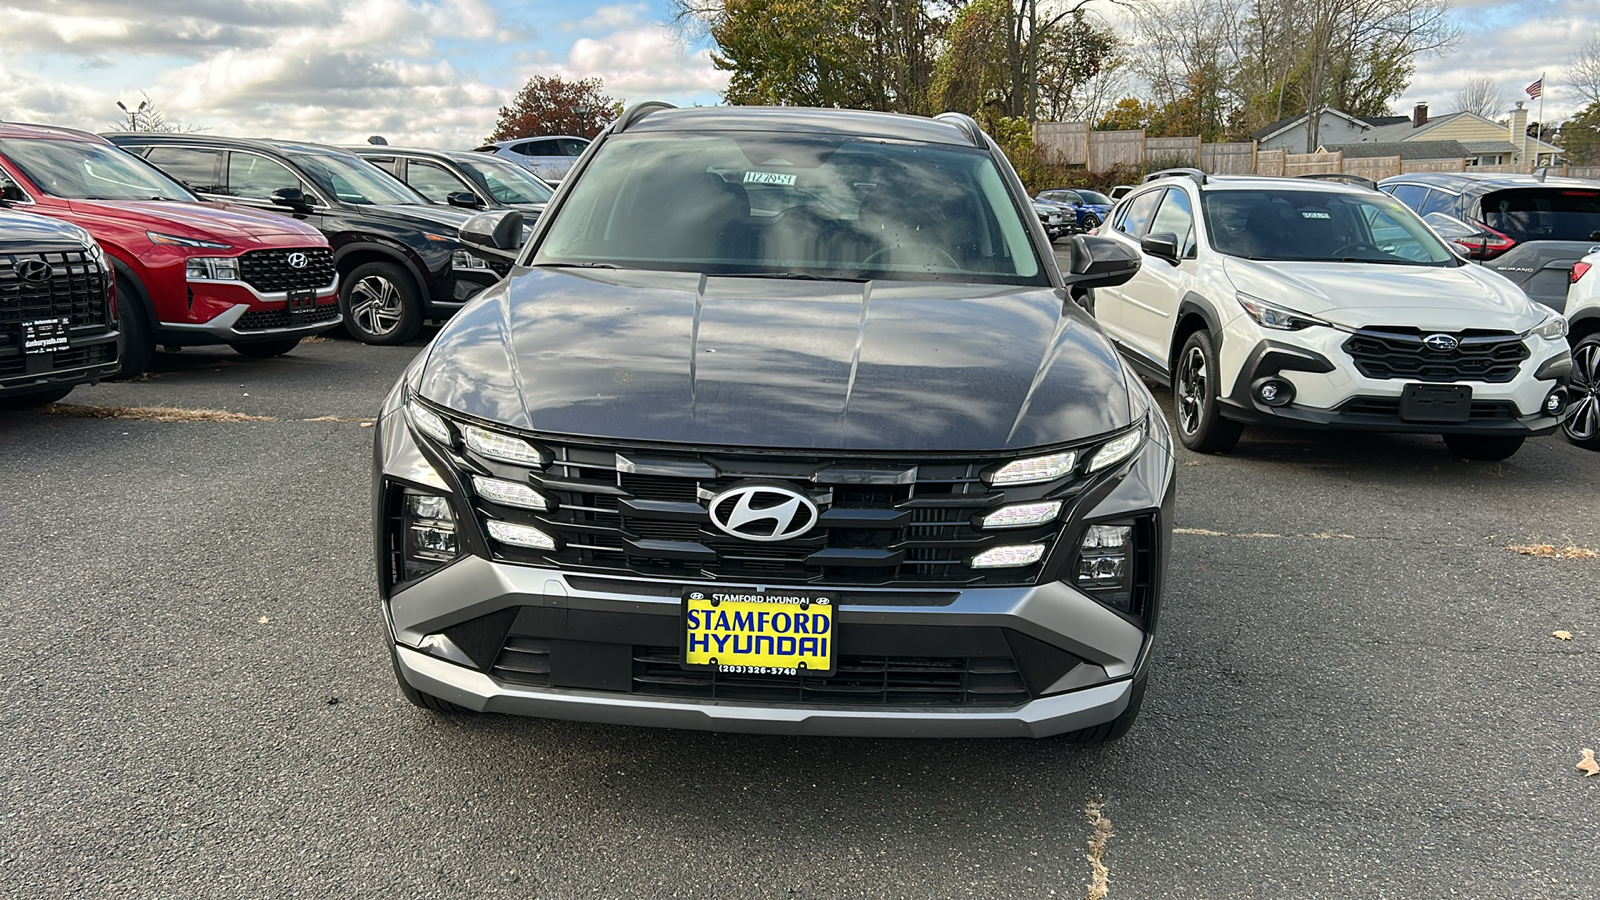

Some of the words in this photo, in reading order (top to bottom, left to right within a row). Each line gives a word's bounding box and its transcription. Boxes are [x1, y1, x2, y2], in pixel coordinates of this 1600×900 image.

[712, 593, 764, 604] STAMFORD
[766, 595, 810, 605] HYUNDAI
[687, 609, 830, 634] STAMFORD
[689, 633, 827, 657] HYUNDAI
